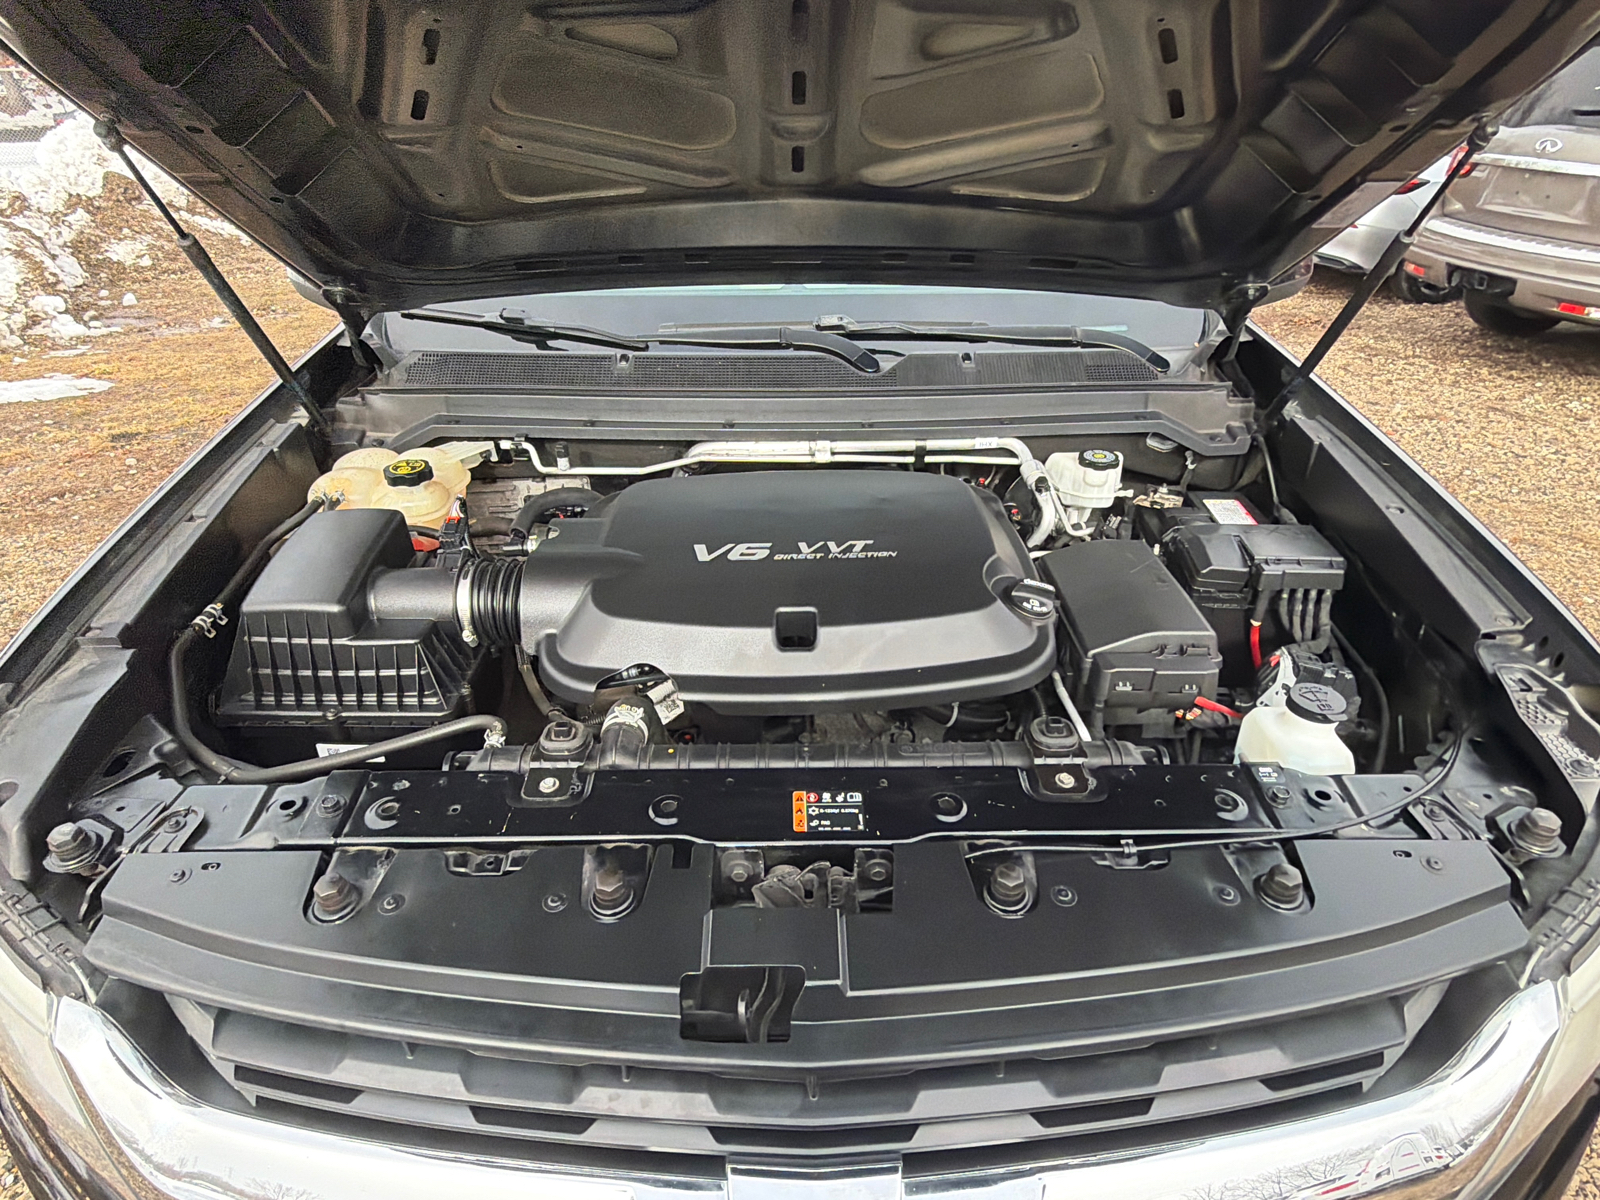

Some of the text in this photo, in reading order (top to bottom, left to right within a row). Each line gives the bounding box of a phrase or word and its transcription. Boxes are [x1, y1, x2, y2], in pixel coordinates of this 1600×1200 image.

[693, 540, 874, 562] V6 VVT
[828, 551, 898, 559] INJECTION
